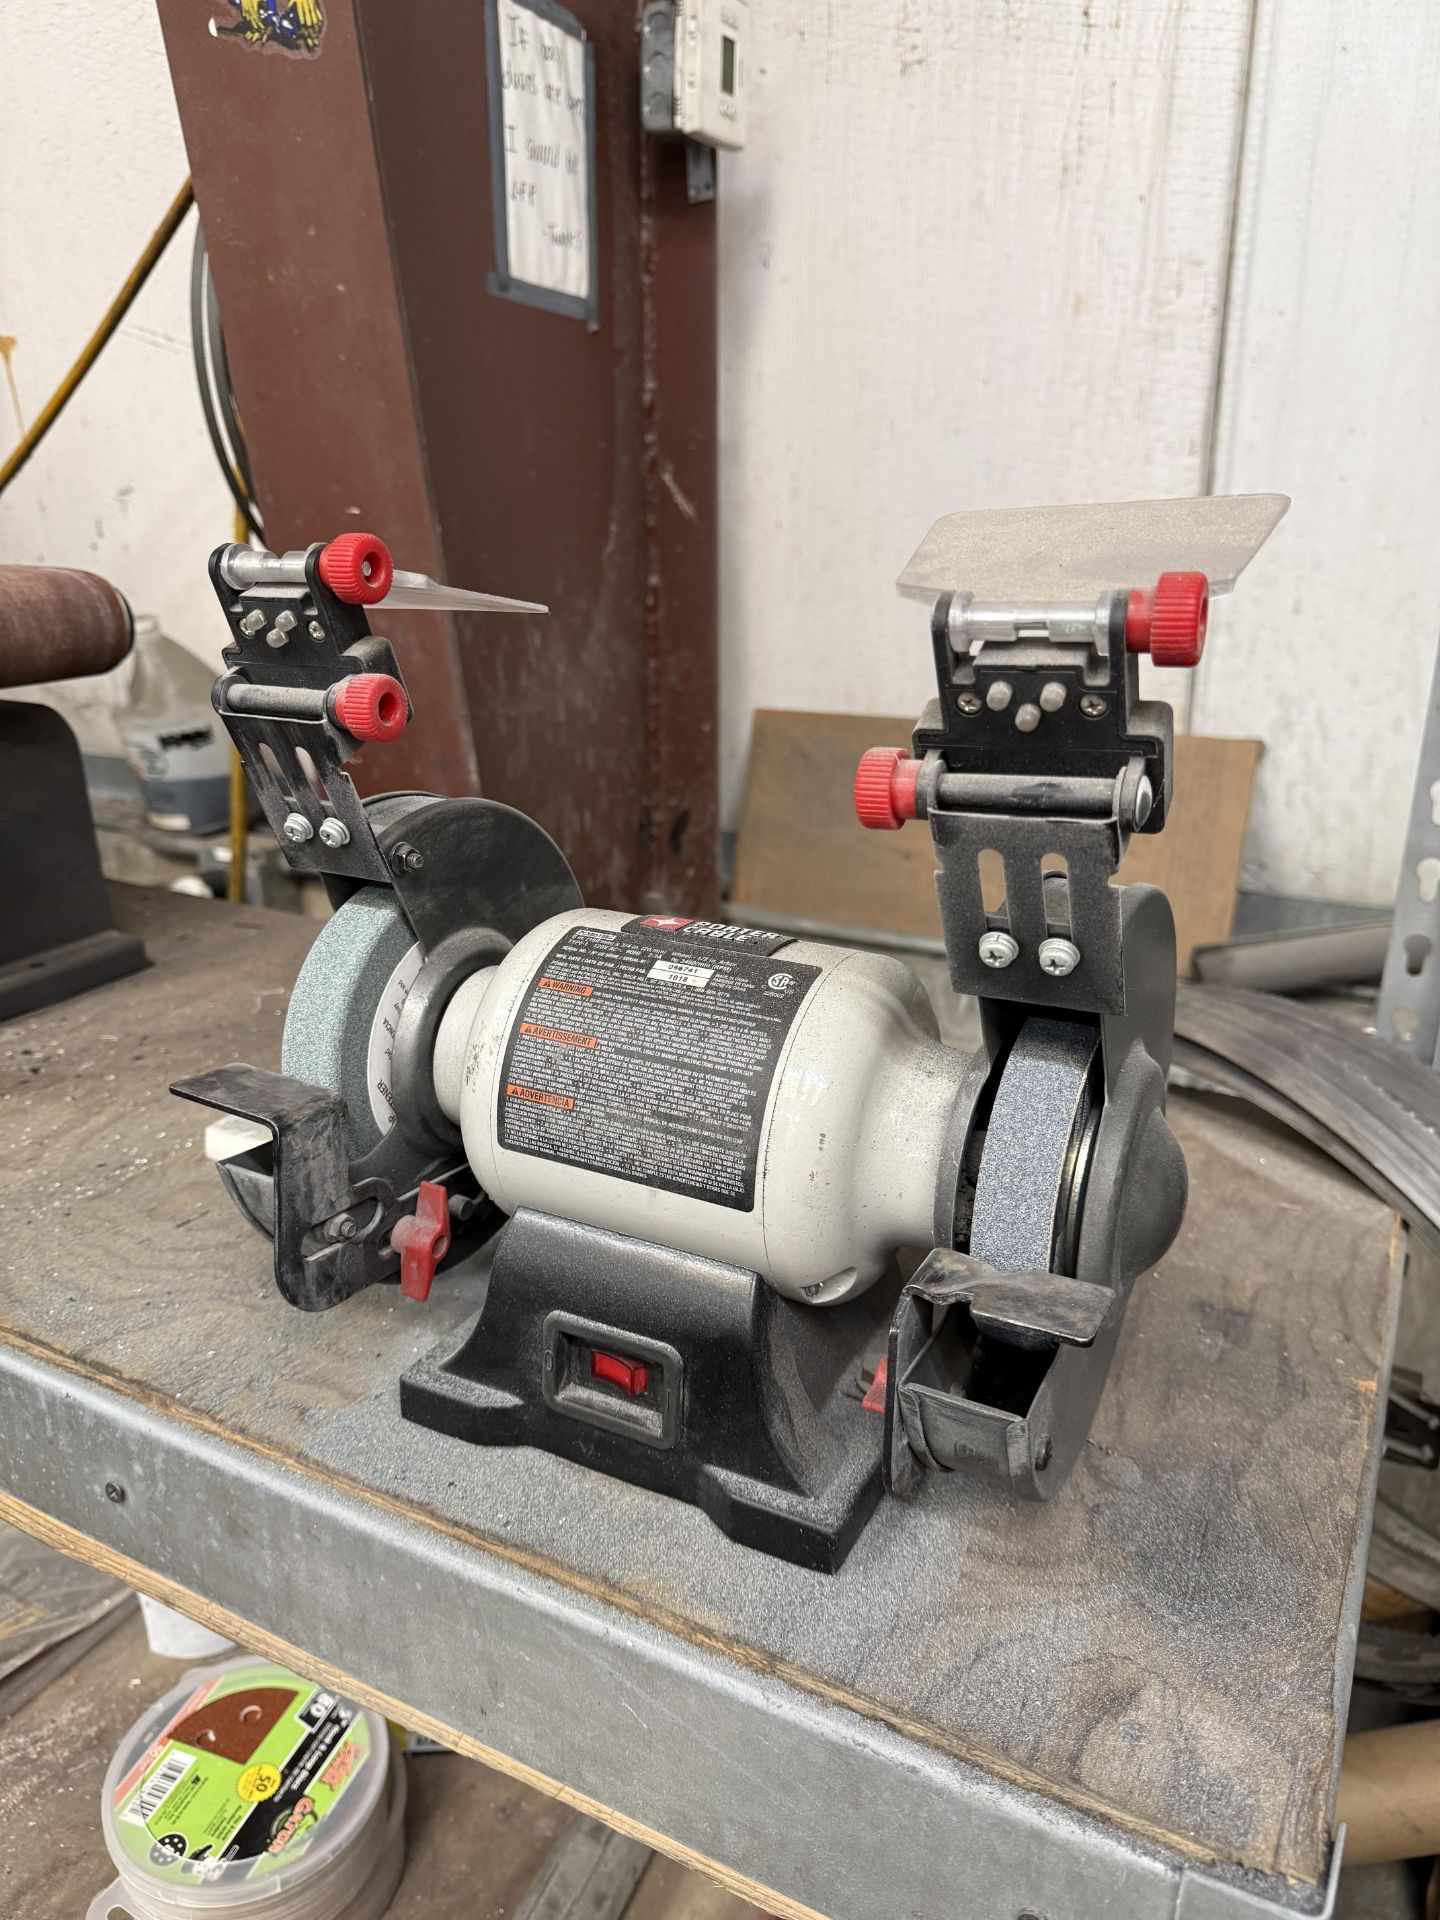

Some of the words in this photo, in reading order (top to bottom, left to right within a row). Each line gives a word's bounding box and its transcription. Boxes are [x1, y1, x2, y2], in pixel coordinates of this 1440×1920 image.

[683, 926, 751, 944] CABLE
[694, 920, 780, 941] PORTER
[550, 979, 587, 995] WARNING
[667, 973, 689, 982] 1018
[533, 1025, 593, 1046] AVERTISSEMENT
[519, 1088, 570, 1108] ADVERTENCIA
[267, 1797, 315, 1853] GATOR
